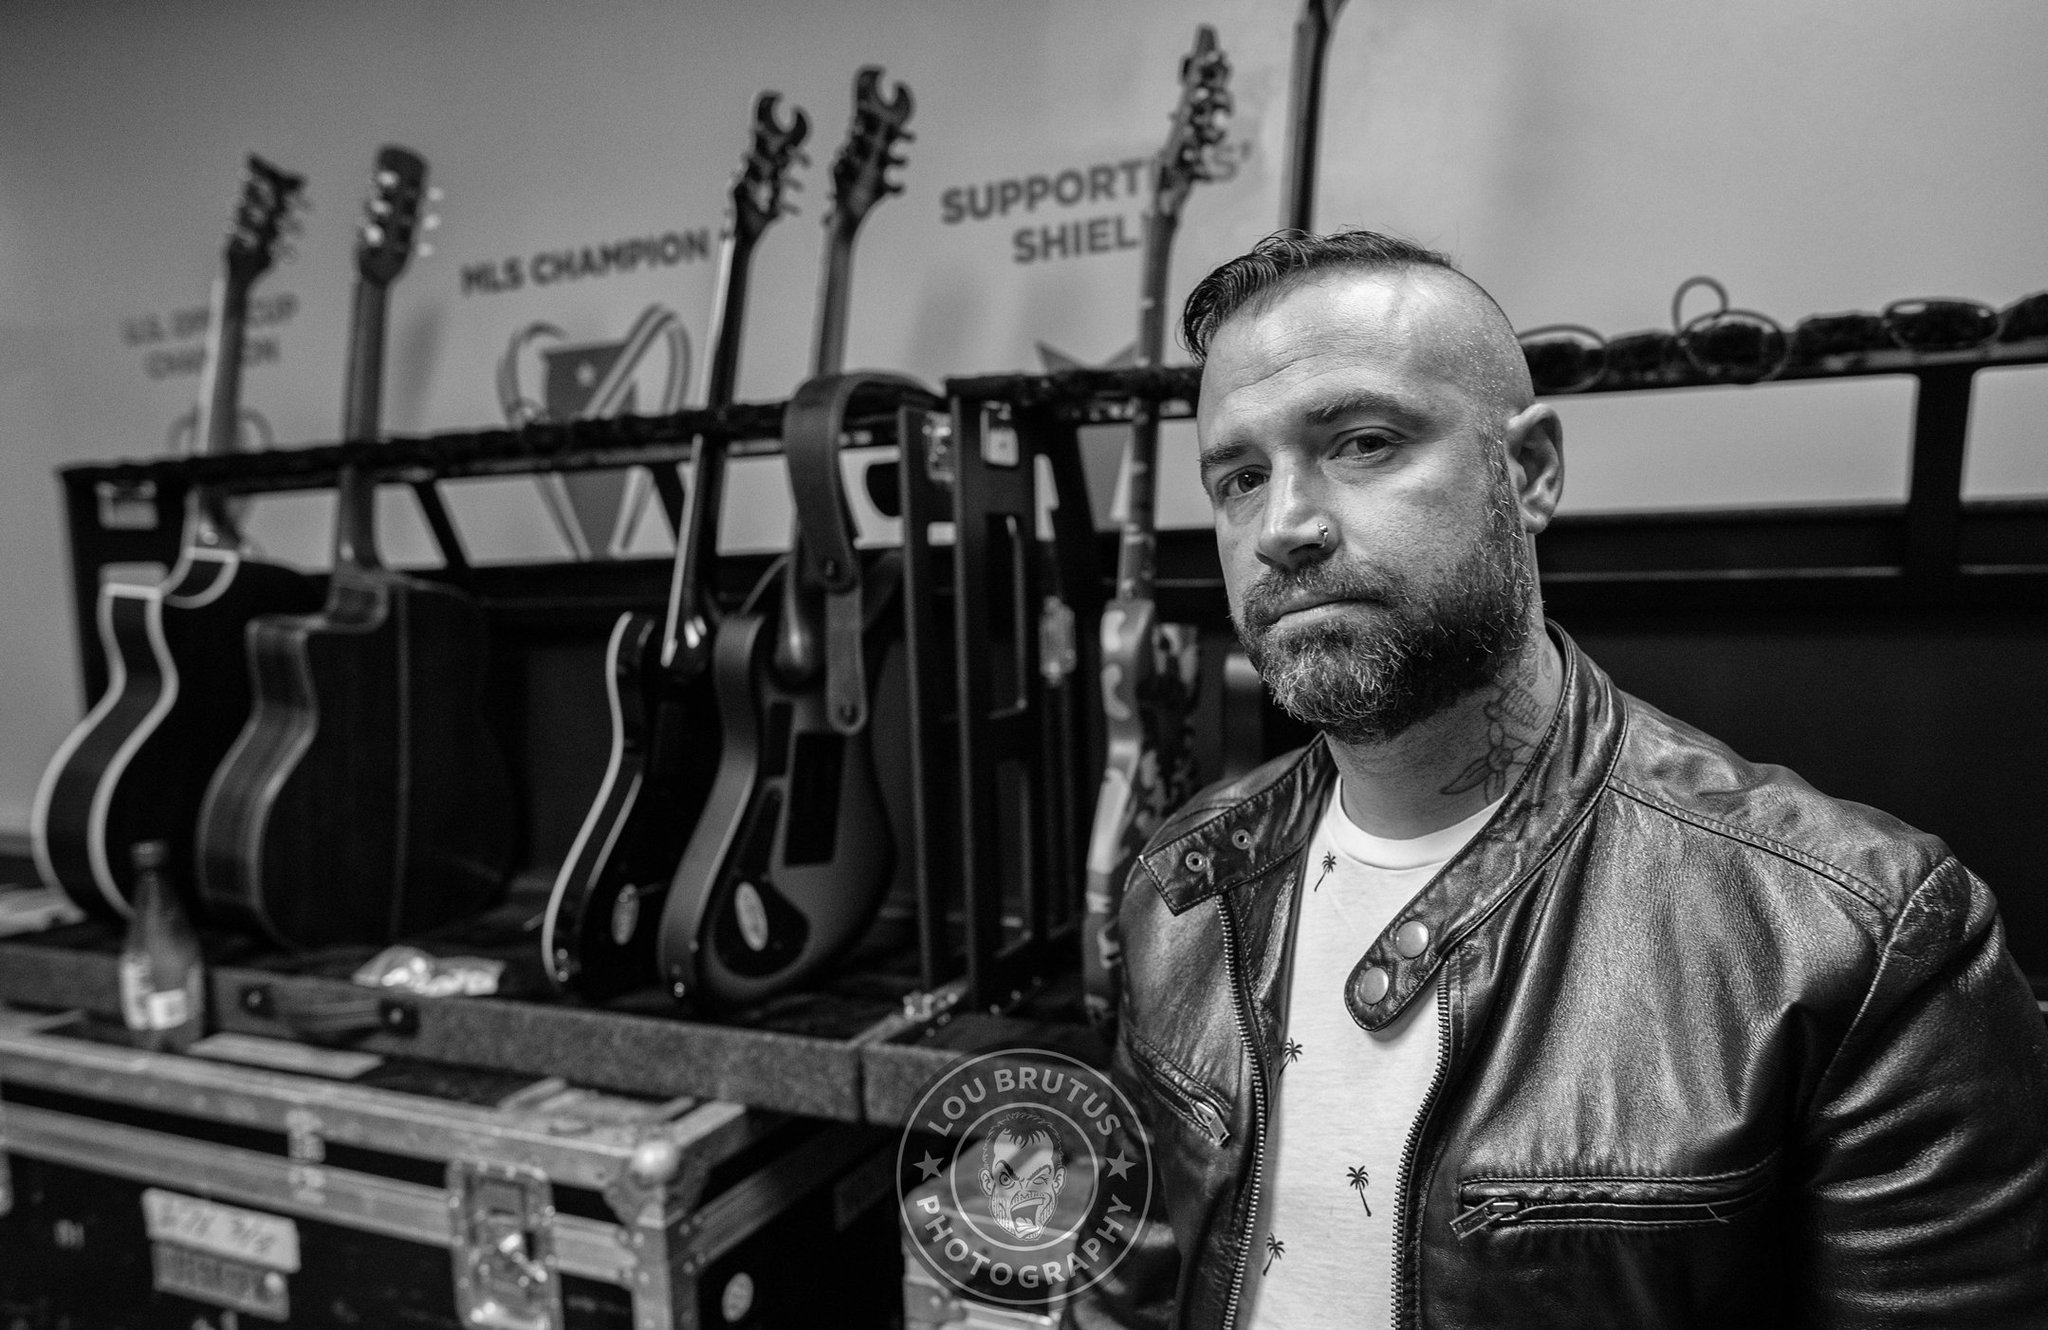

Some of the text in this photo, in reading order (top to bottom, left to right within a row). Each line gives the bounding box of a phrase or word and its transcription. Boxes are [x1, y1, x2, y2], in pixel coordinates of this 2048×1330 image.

[460, 229, 710, 299] MLS CHAMPION
[1012, 211, 1148, 265] SHIEL
